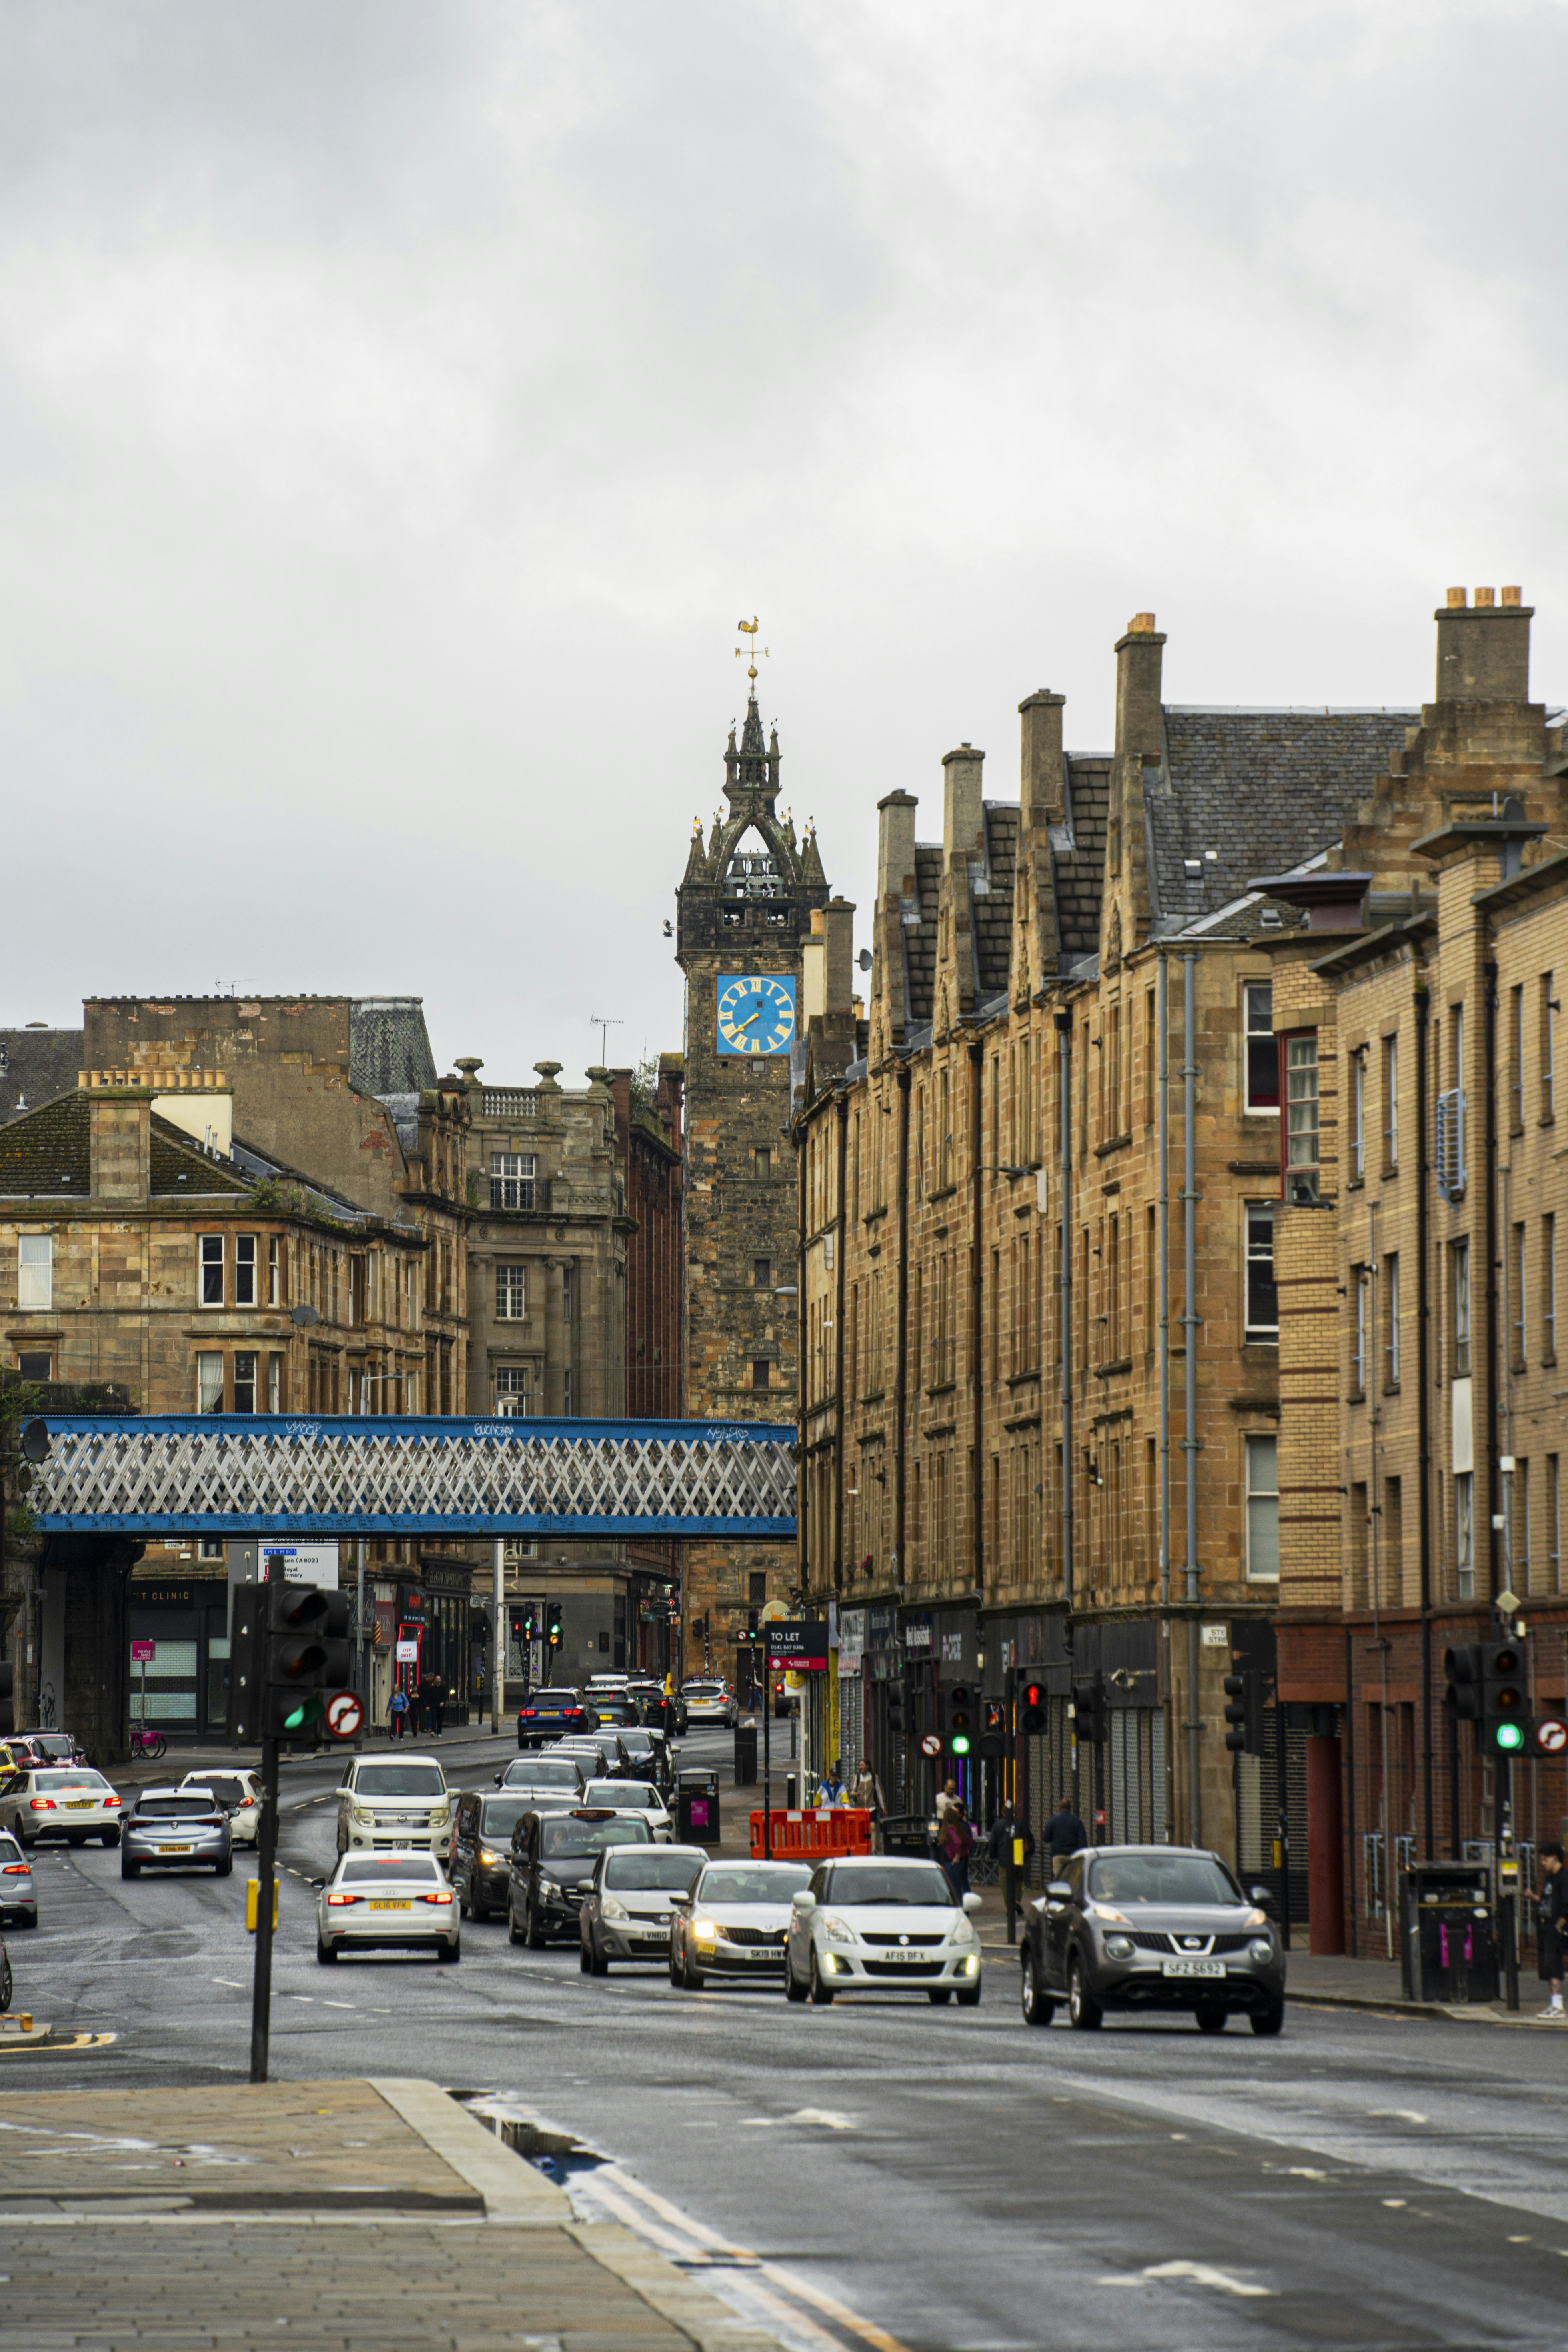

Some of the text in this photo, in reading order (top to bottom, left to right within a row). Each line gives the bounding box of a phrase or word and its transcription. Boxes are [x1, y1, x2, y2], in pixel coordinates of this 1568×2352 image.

[106, 1385, 114, 1394] 4
[152, 1592, 189, 1600] CLINIC
[771, 1633, 799, 1641] TO LET
[751, 1950, 769, 1958] SK19
[885, 1952, 925, 1960] AF15 BFX
[1169, 1962, 1220, 1974] SFZ 5692
